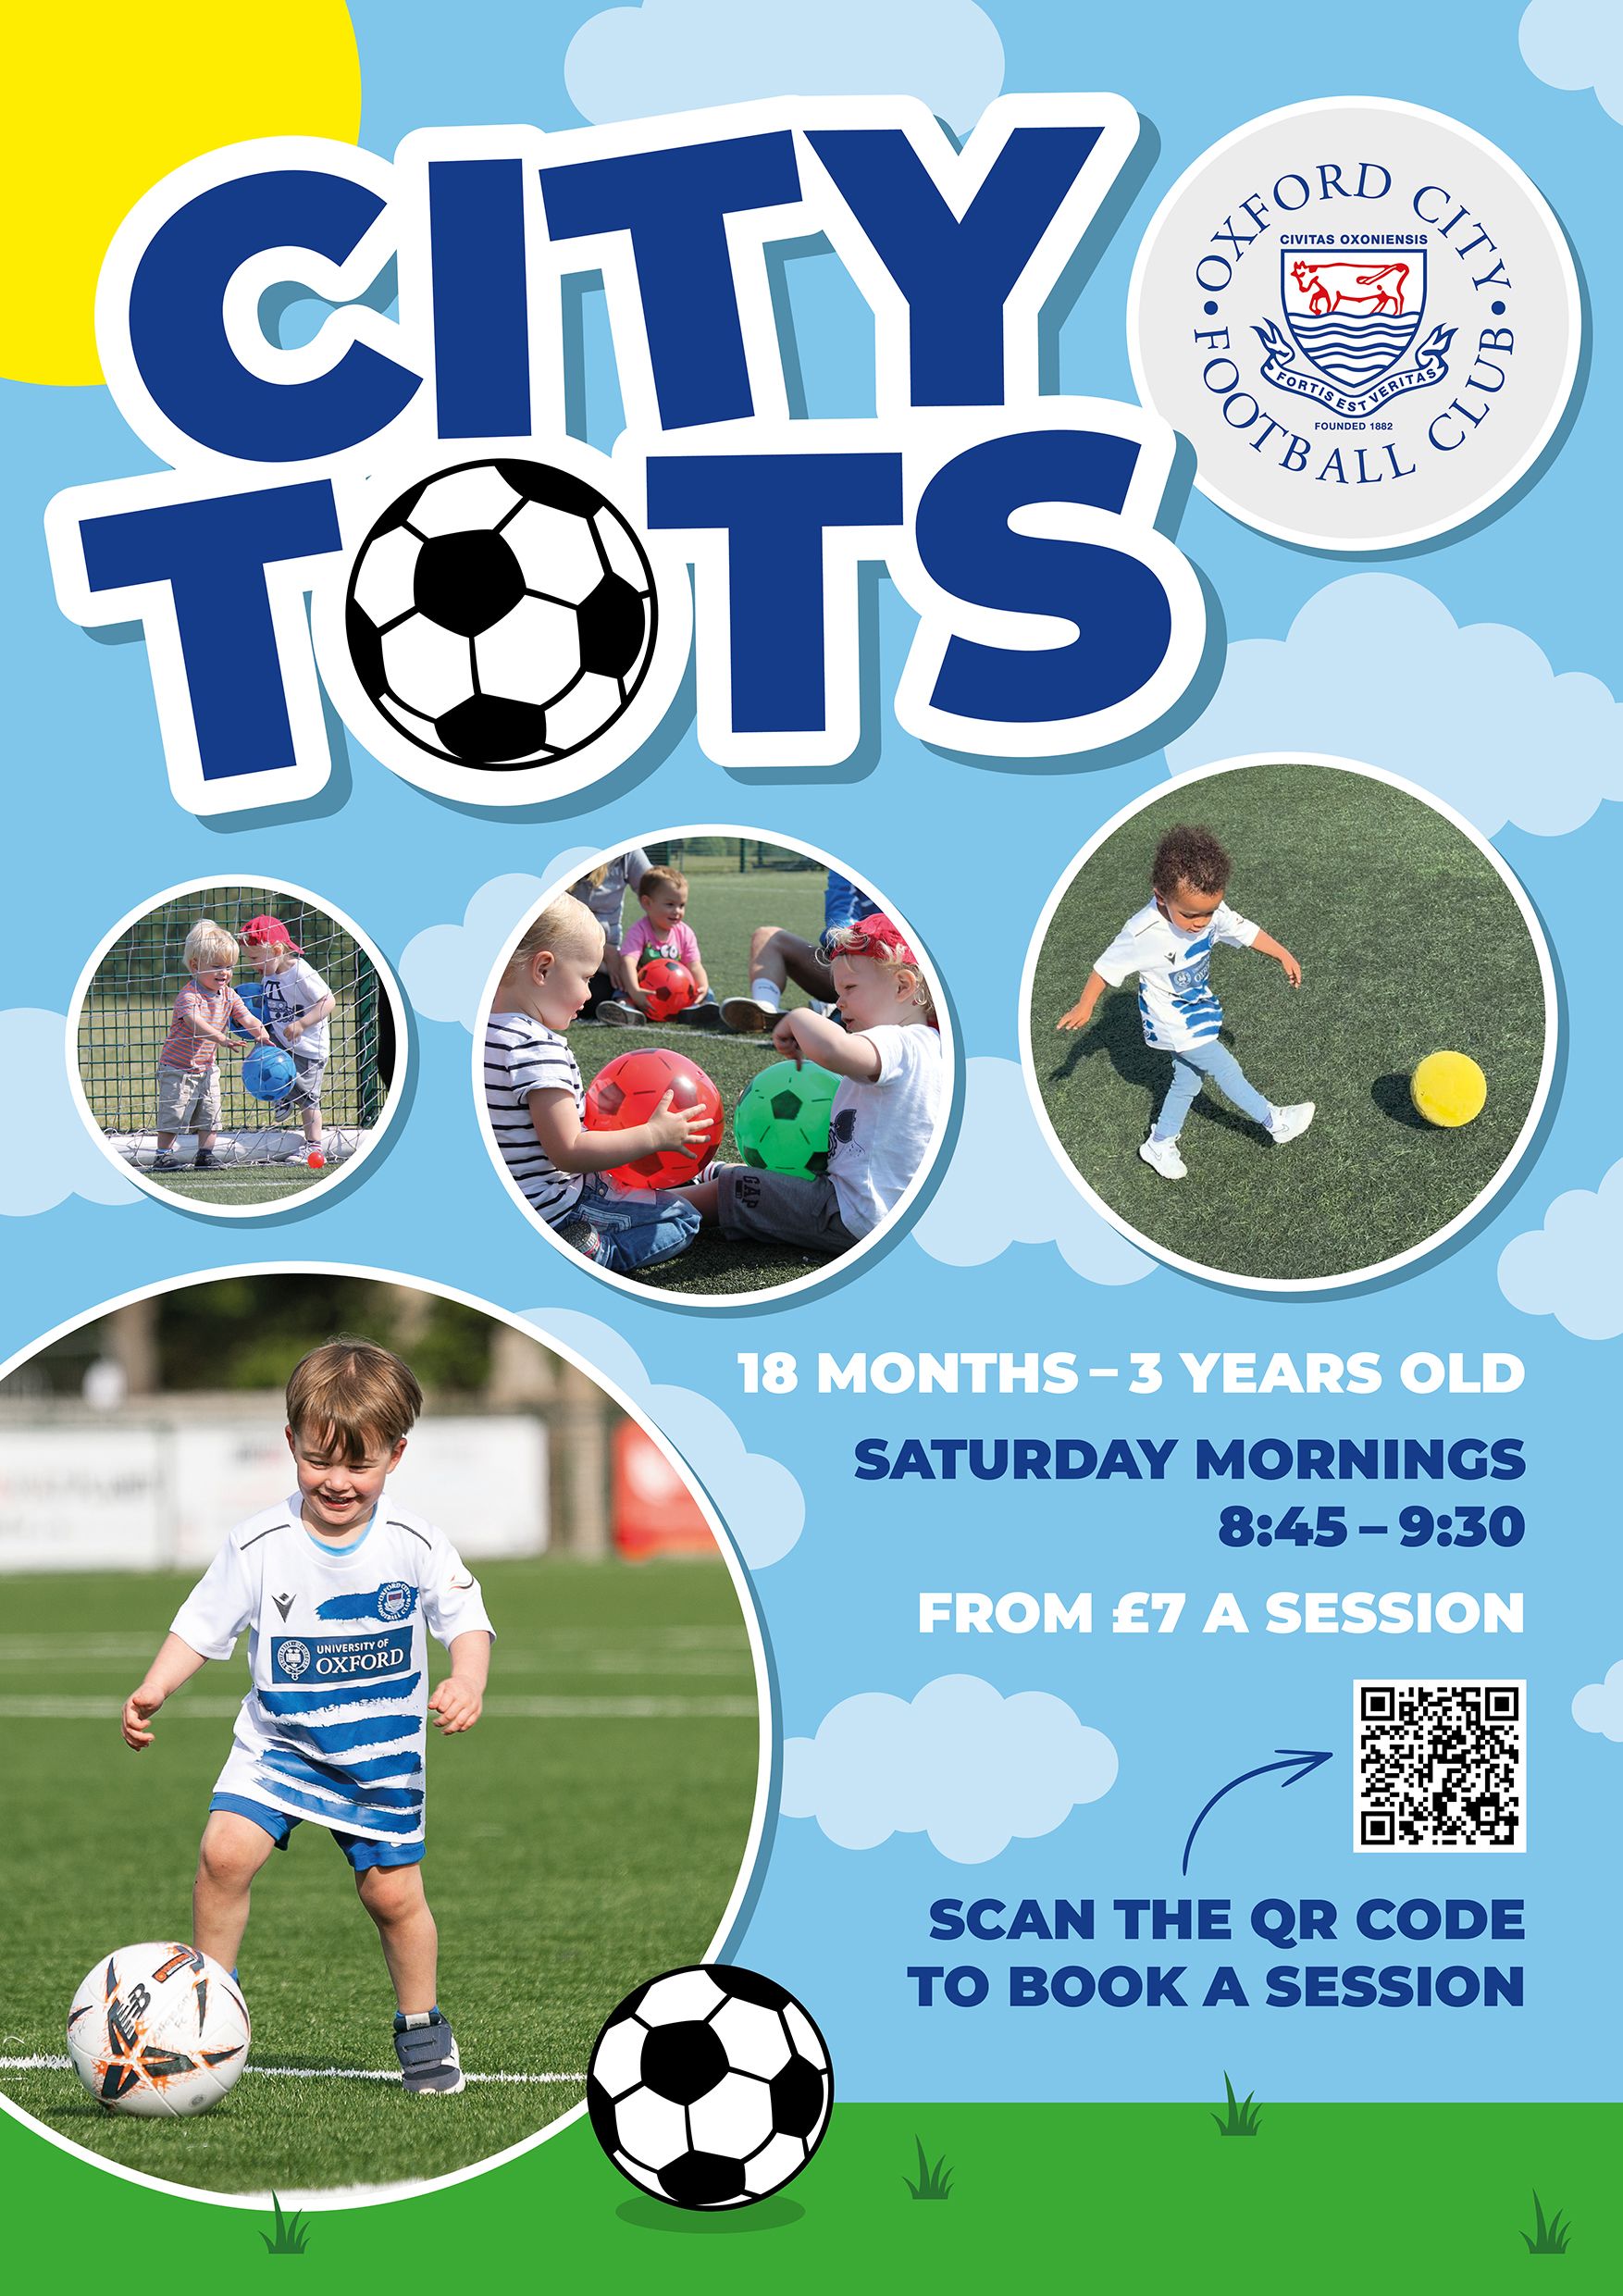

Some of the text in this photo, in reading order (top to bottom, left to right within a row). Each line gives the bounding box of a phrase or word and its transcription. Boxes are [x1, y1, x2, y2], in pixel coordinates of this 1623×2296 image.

[1196, 162, 1512, 292] OXFORD CITY
[1280, 233, 1429, 245] CIVITAS OXONIENSIS
[129, 126, 1106, 464] CITY
[1194, 325, 1515, 485] FOOTBALL CLUB
[1276, 368, 1437, 413] FORTIS EST VERITAS
[1314, 421, 1394, 431] FOUNDED 1882
[742, 1175, 761, 1209] GAP
[737, 1352, 797, 1394] 18
[818, 1352, 1079, 1395] MONTHS
[1128, 1352, 1162, 1394] 3
[1179, 1352, 1382, 1394] YEARS
[1400, 1351, 1524, 1395] OLD
[853, 1438, 1527, 1481] SATURDAY MORNINGS
[1218, 1505, 1348, 1548] 8:45
[1397, 1505, 1526, 1548] 9:30
[918, 1592, 1524, 1634] FROM £7 A SESSION
[316, 1638, 390, 1655] UNIVERSITY OF
[316, 1648, 404, 1675] OXFORD
[928, 1898, 1526, 1950] SCAN THE QR CODE
[907, 1965, 1525, 2008] TO BOOK A SESSION
